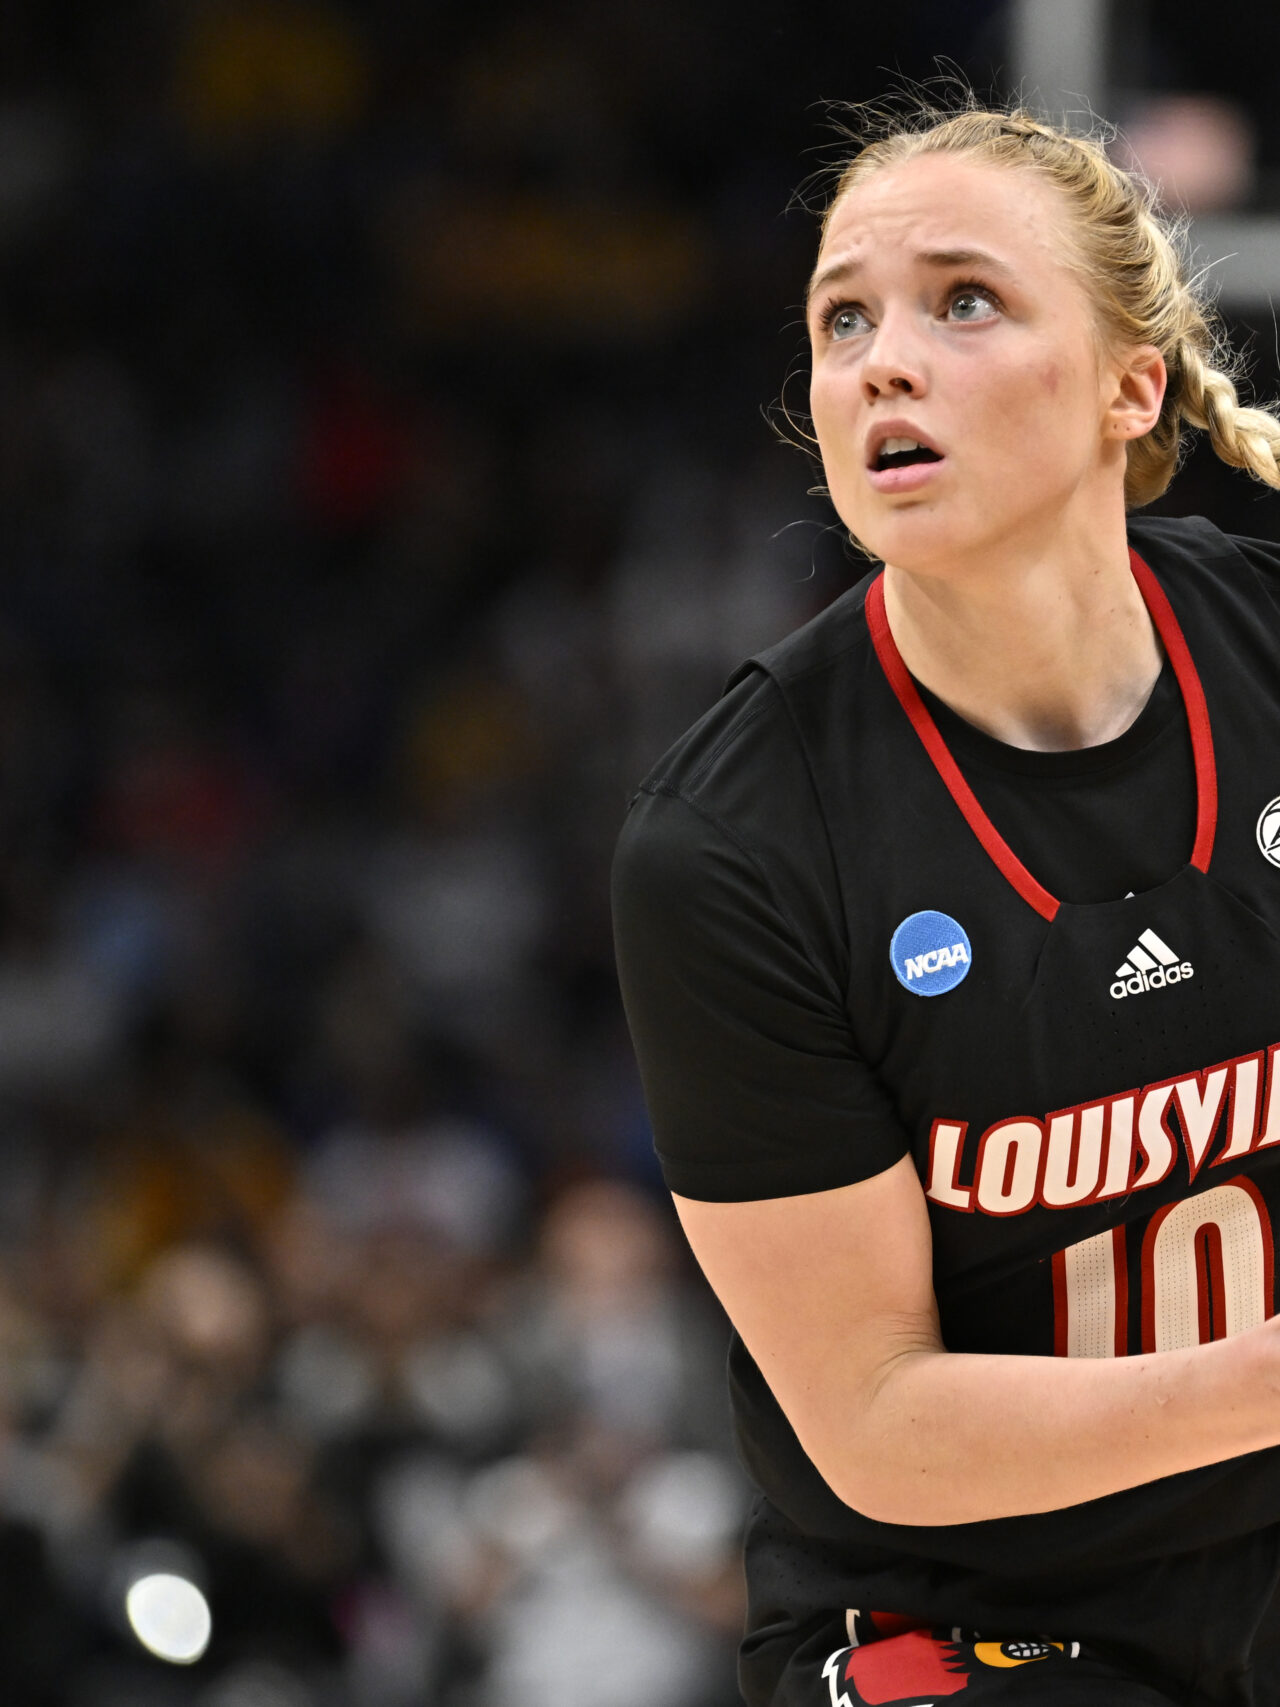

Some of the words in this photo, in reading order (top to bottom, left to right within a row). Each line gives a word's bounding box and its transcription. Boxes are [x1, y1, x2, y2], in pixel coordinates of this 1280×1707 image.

[904, 942, 969, 980] NCAA
[1109, 961, 1194, 999] adidas
[1052, 1174, 1275, 1358] 10
